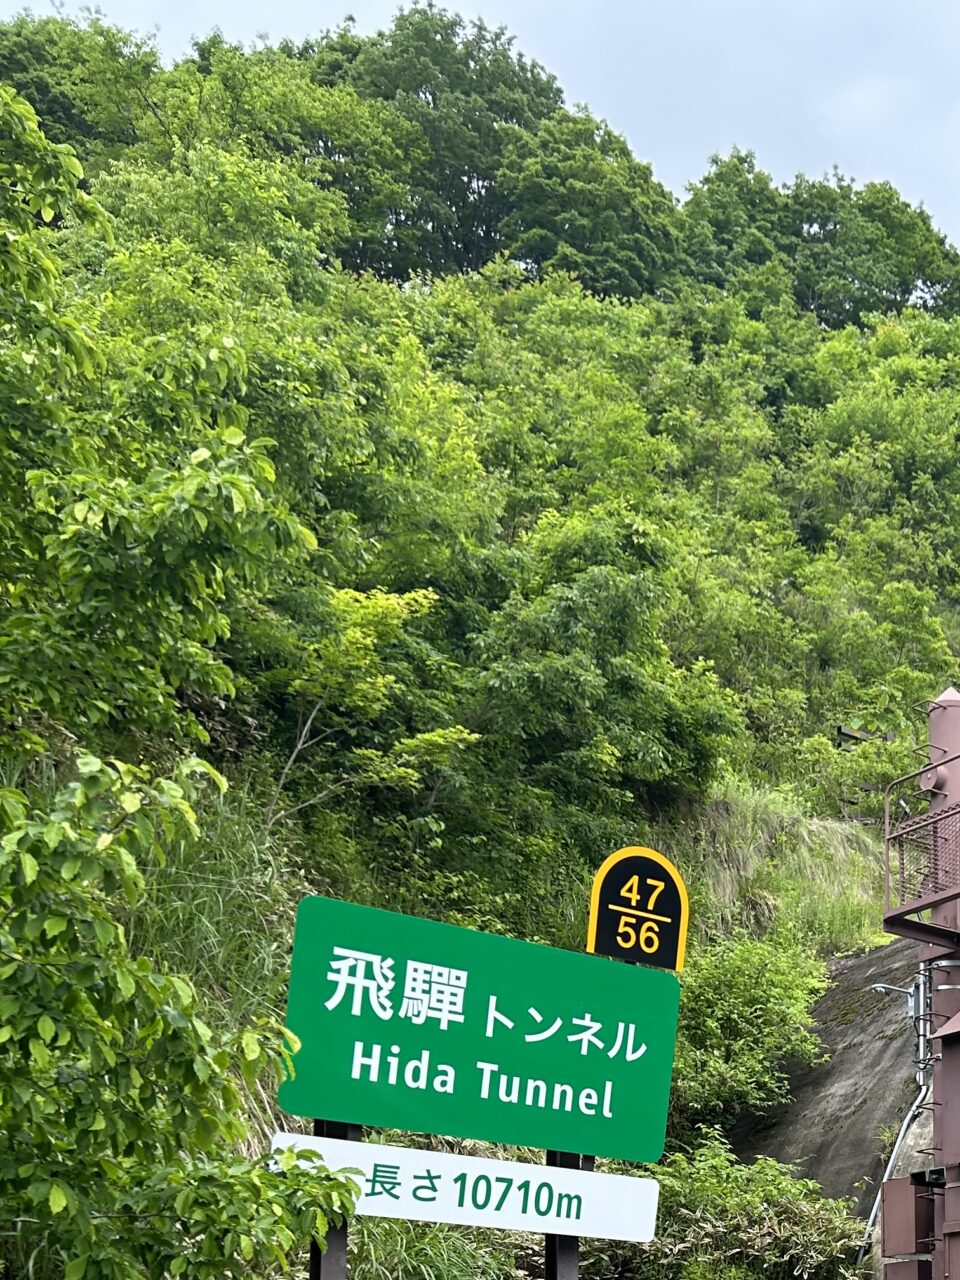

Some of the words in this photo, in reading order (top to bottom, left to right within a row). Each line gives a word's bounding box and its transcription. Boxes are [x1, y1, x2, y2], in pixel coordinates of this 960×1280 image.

[620, 875, 665, 910] 47
[616, 917, 660, 954] 56
[485, 995, 648, 1062] トンネル
[350, 1041, 456, 1094] Hida
[476, 1061, 614, 1118] Tunnel
